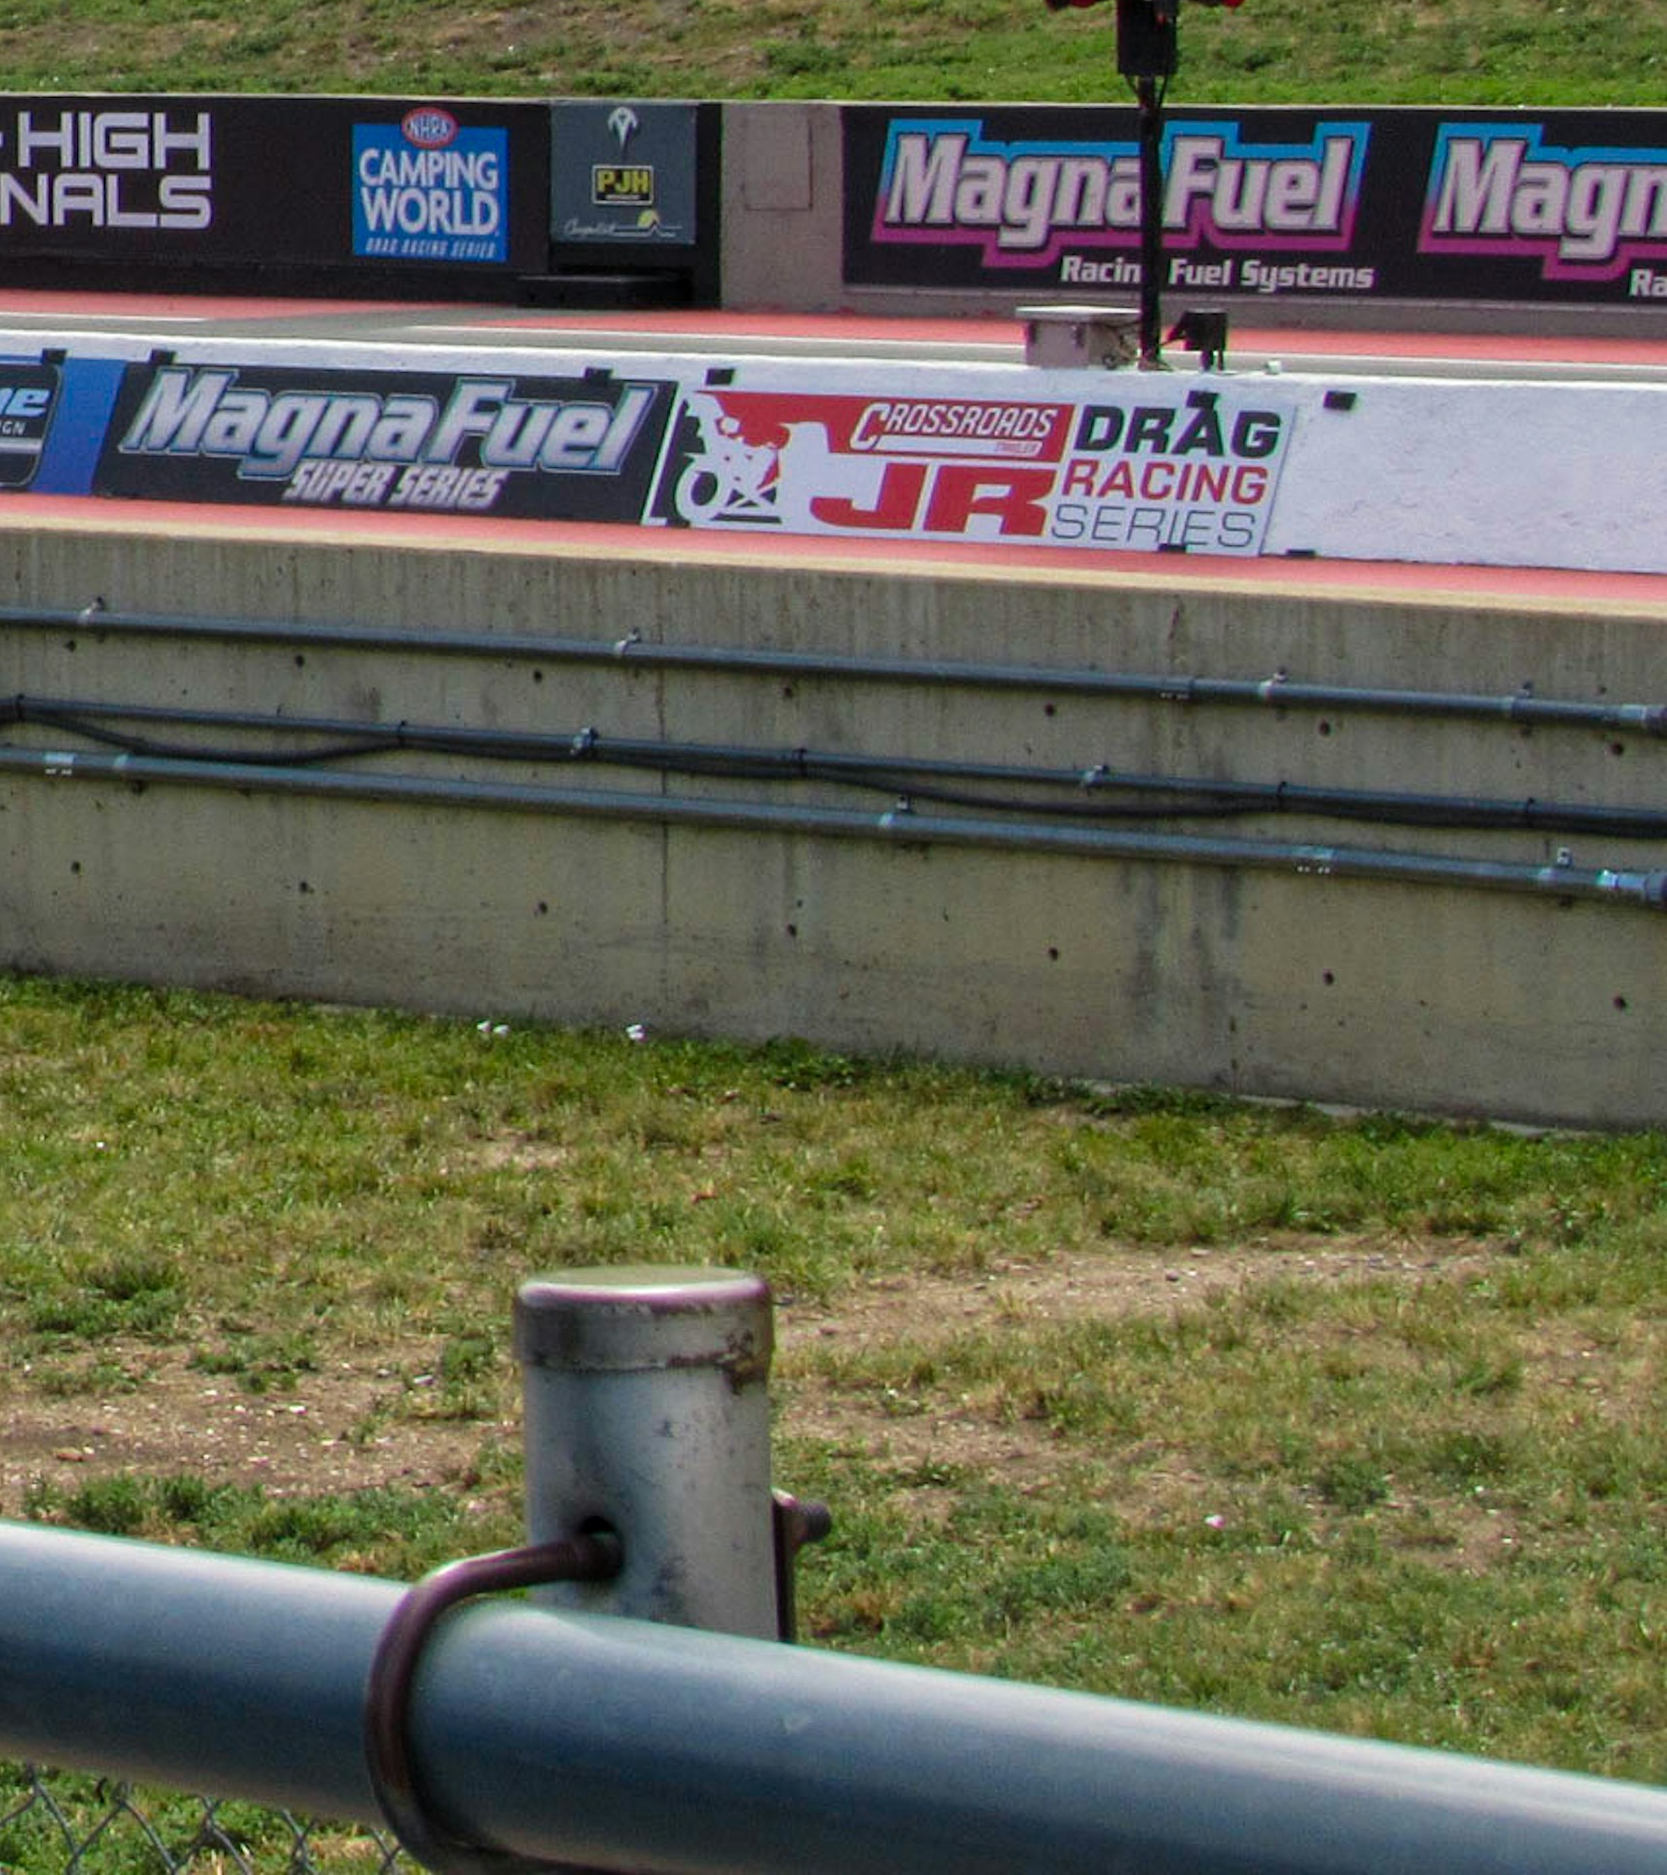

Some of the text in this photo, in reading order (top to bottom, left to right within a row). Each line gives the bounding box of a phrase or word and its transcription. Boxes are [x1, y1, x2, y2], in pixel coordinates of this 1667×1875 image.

[358, 148, 499, 191] CAMPING
[597, 170, 650, 193] PJH
[882, 131, 1354, 249] MagnaFuel
[360, 187, 500, 237] WORLD
[1060, 255, 1375, 293] Racin Fuel Systems
[119, 366, 660, 481] MagnaFuel
[849, 402, 1058, 451] CROSSROADS
[1073, 404, 1282, 459] DRAG
[282, 460, 510, 509] SUPER SERIES
[809, 461, 1058, 536] JR
[1060, 458, 1268, 505] RACING
[1050, 503, 1257, 548] SERIES
